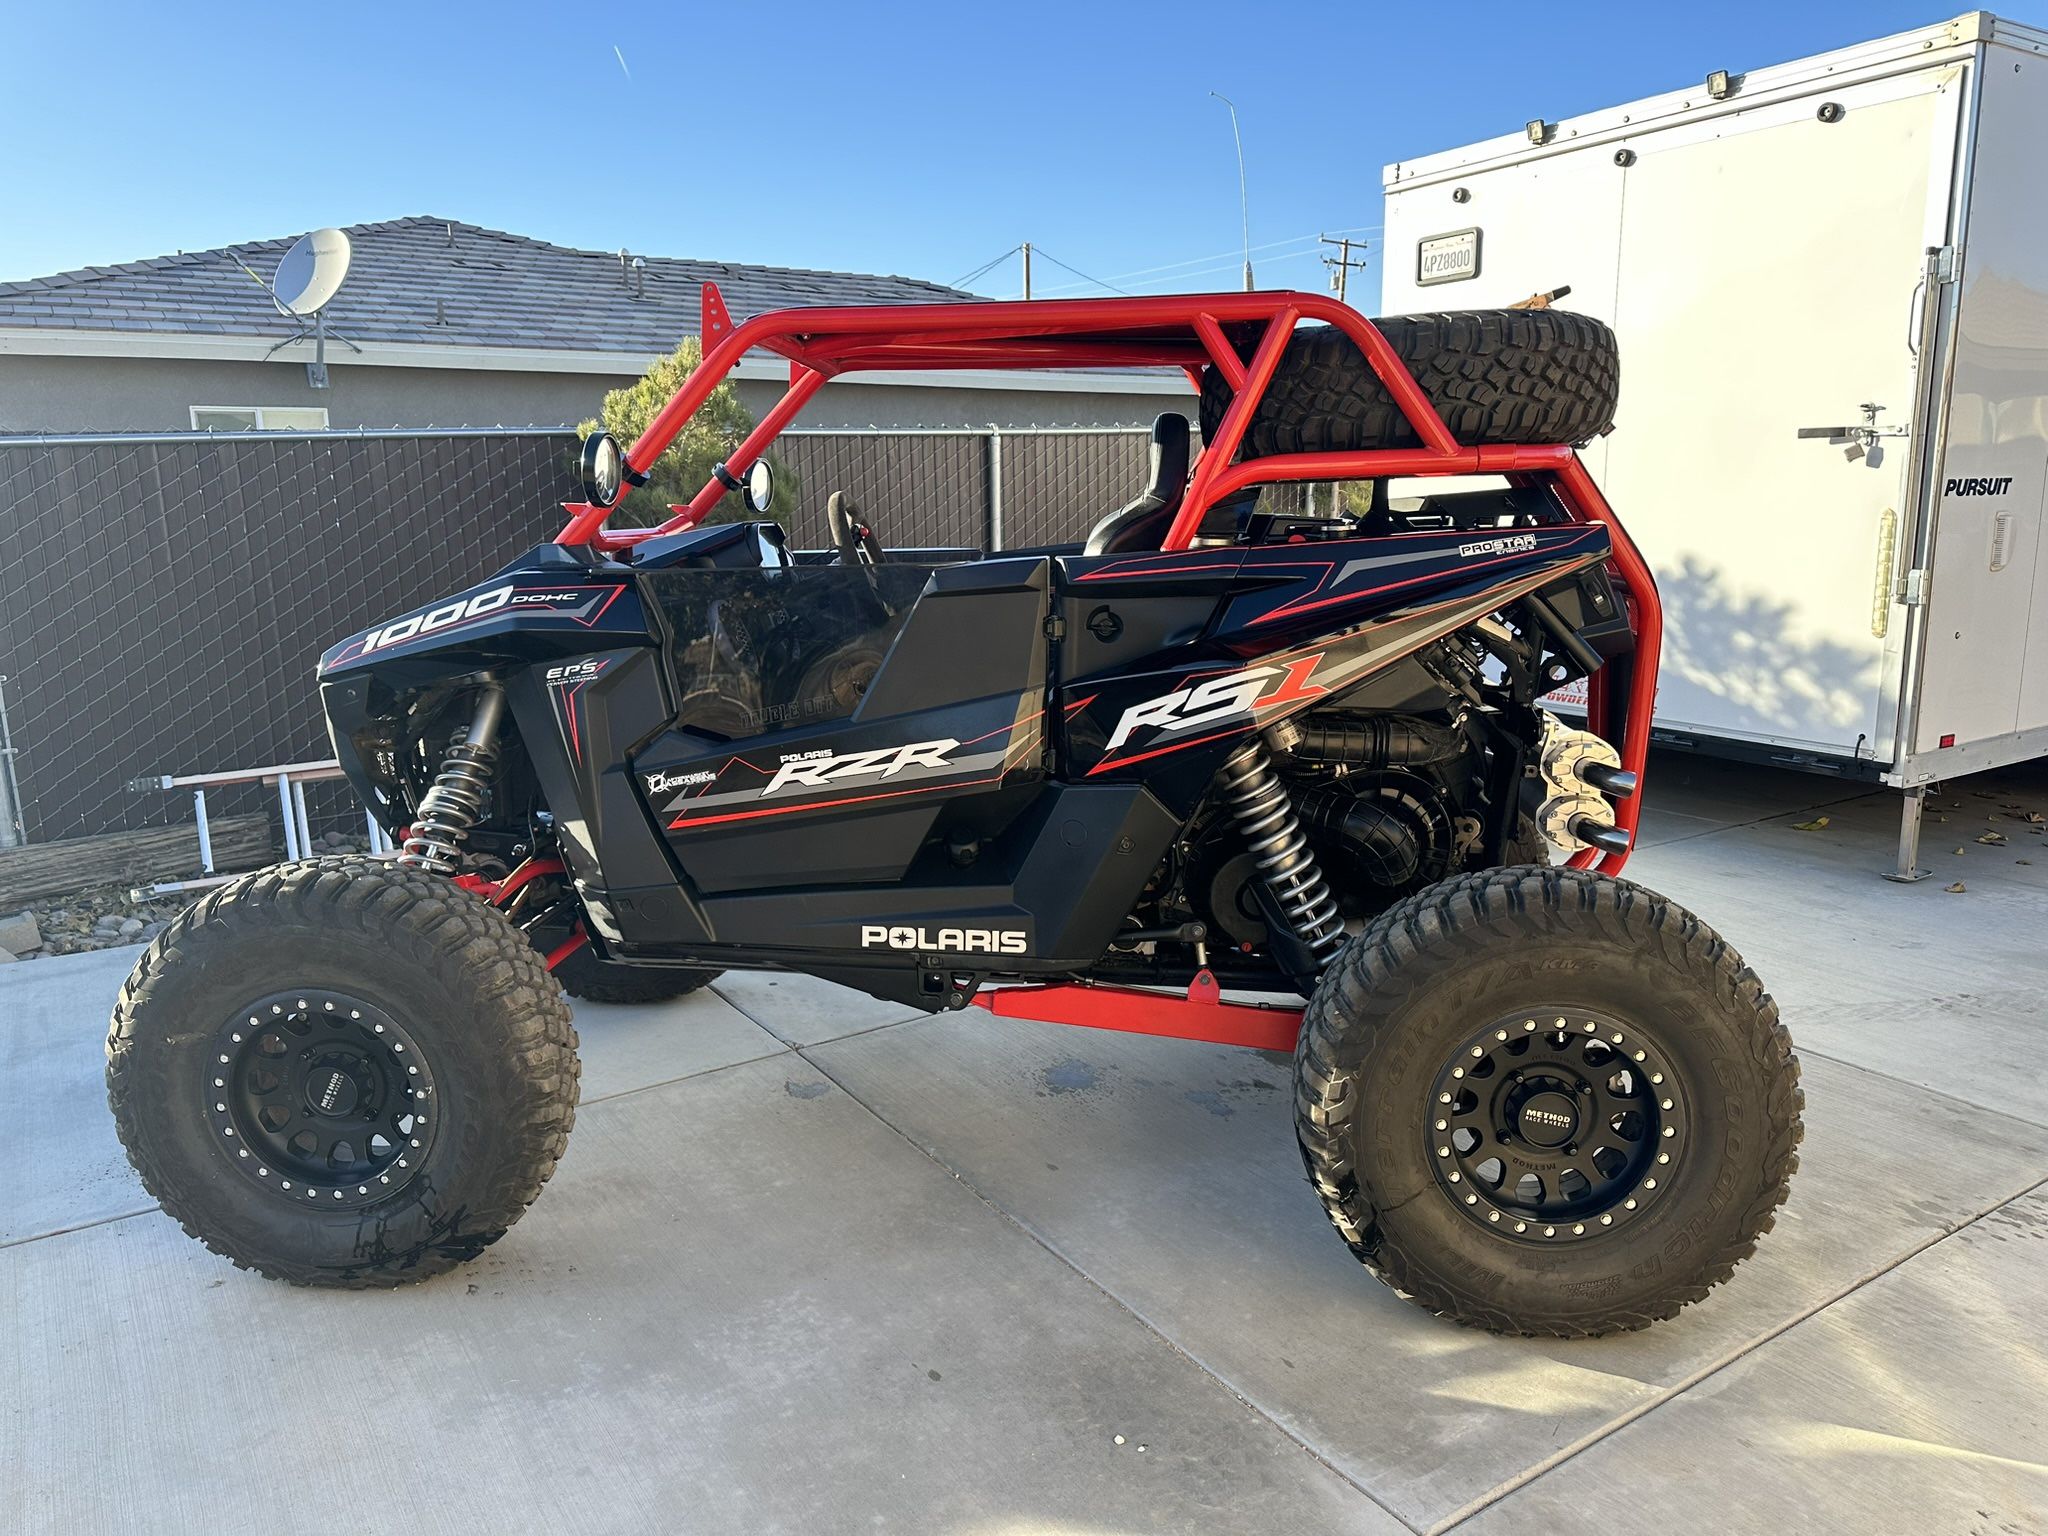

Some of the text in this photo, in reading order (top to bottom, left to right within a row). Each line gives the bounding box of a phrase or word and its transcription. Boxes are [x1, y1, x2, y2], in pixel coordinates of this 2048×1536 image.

[1424, 249, 1470, 273] 4PZ8800
[1944, 477, 2012, 497] PURSUIT
[1460, 533, 1536, 556] PROSTAR
[361, 585, 579, 653] 1000 DOHC
[546, 661, 598, 679] EPS
[1105, 652, 1332, 751] RS1
[759, 738, 961, 797] RZR
[780, 749, 834, 763] POLARIS
[861, 925, 1027, 954] POLARIS
[320, 1072, 340, 1109] METHOD
[1525, 1109, 1571, 1123] METHOD
[1525, 1115, 1570, 1129] RACE WHEELS
